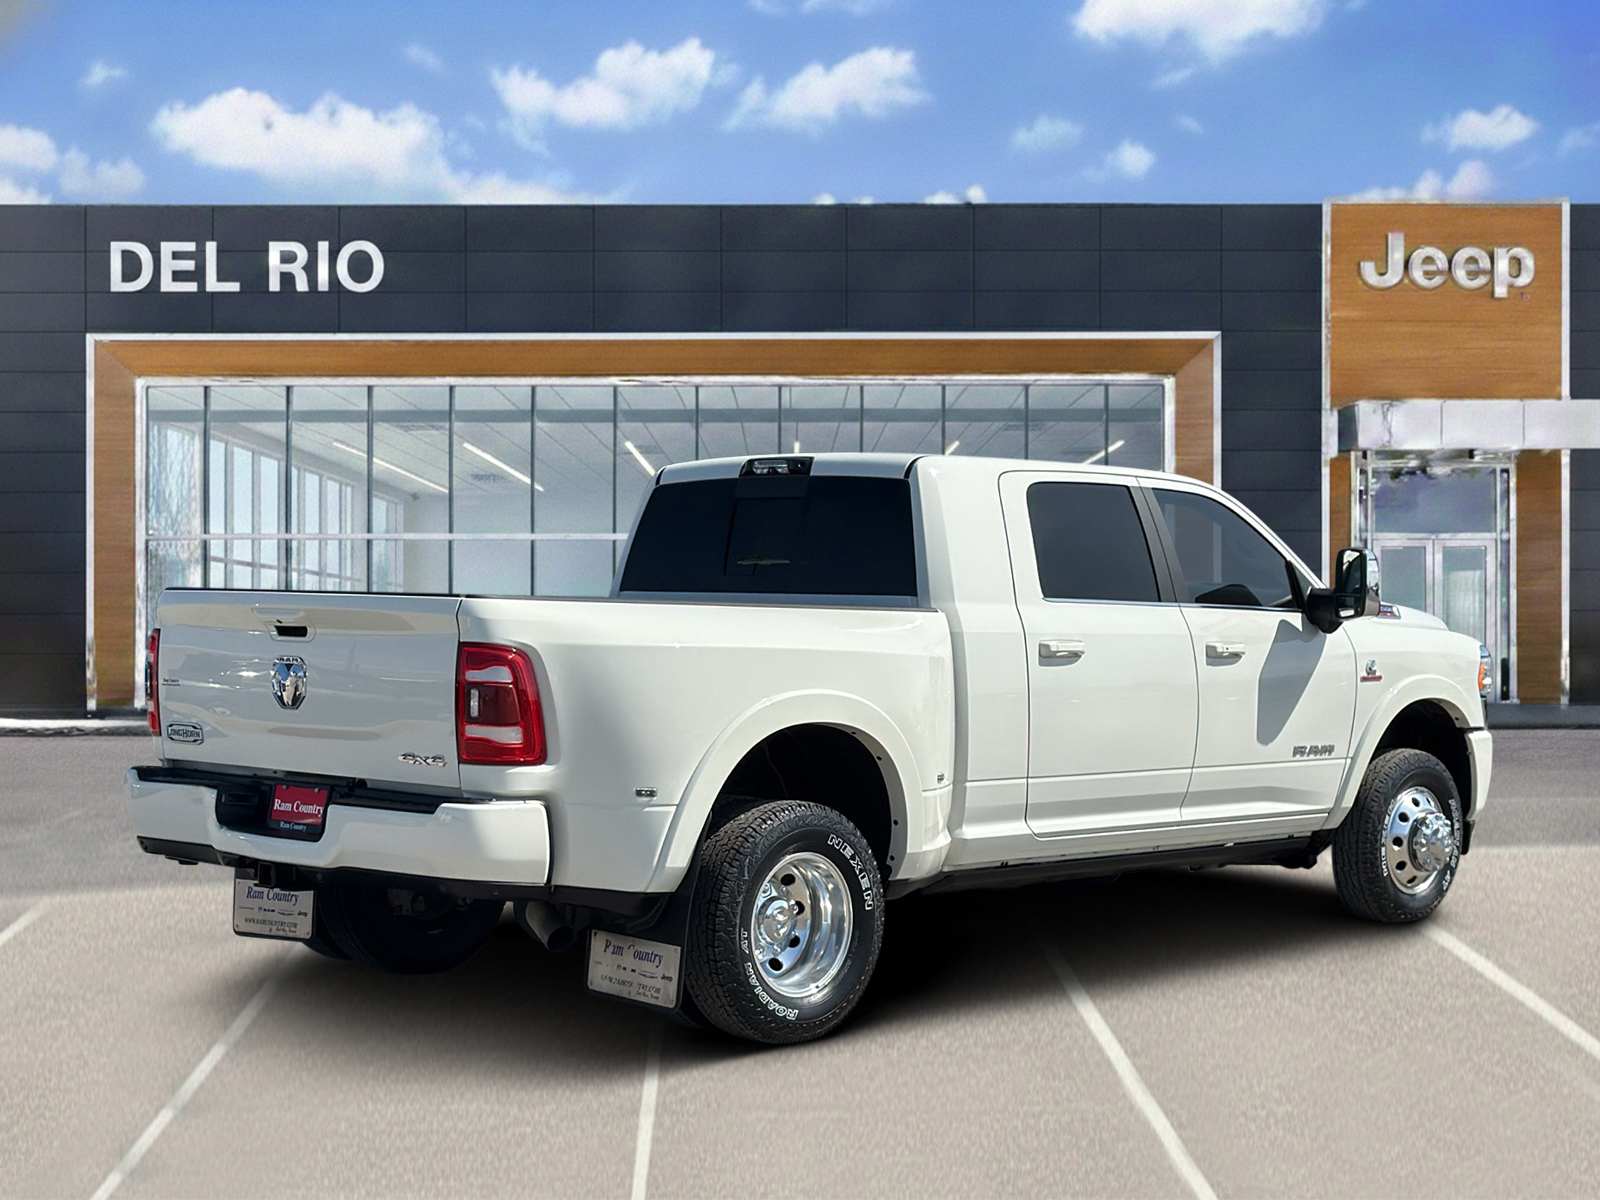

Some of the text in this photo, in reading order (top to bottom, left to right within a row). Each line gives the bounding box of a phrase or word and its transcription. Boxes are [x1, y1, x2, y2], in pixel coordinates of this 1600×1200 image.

[110, 240, 385, 293] DEL RIO
[1360, 232, 1535, 298] Jeep
[1292, 744, 1335, 757] RAM
[274, 798, 324, 817] Ram Country
[280, 821, 290, 829] Ram
[827, 834, 874, 910] NEXEN
[246, 886, 299, 906] Ram Country
[744, 962, 799, 1020] ROADIAN
